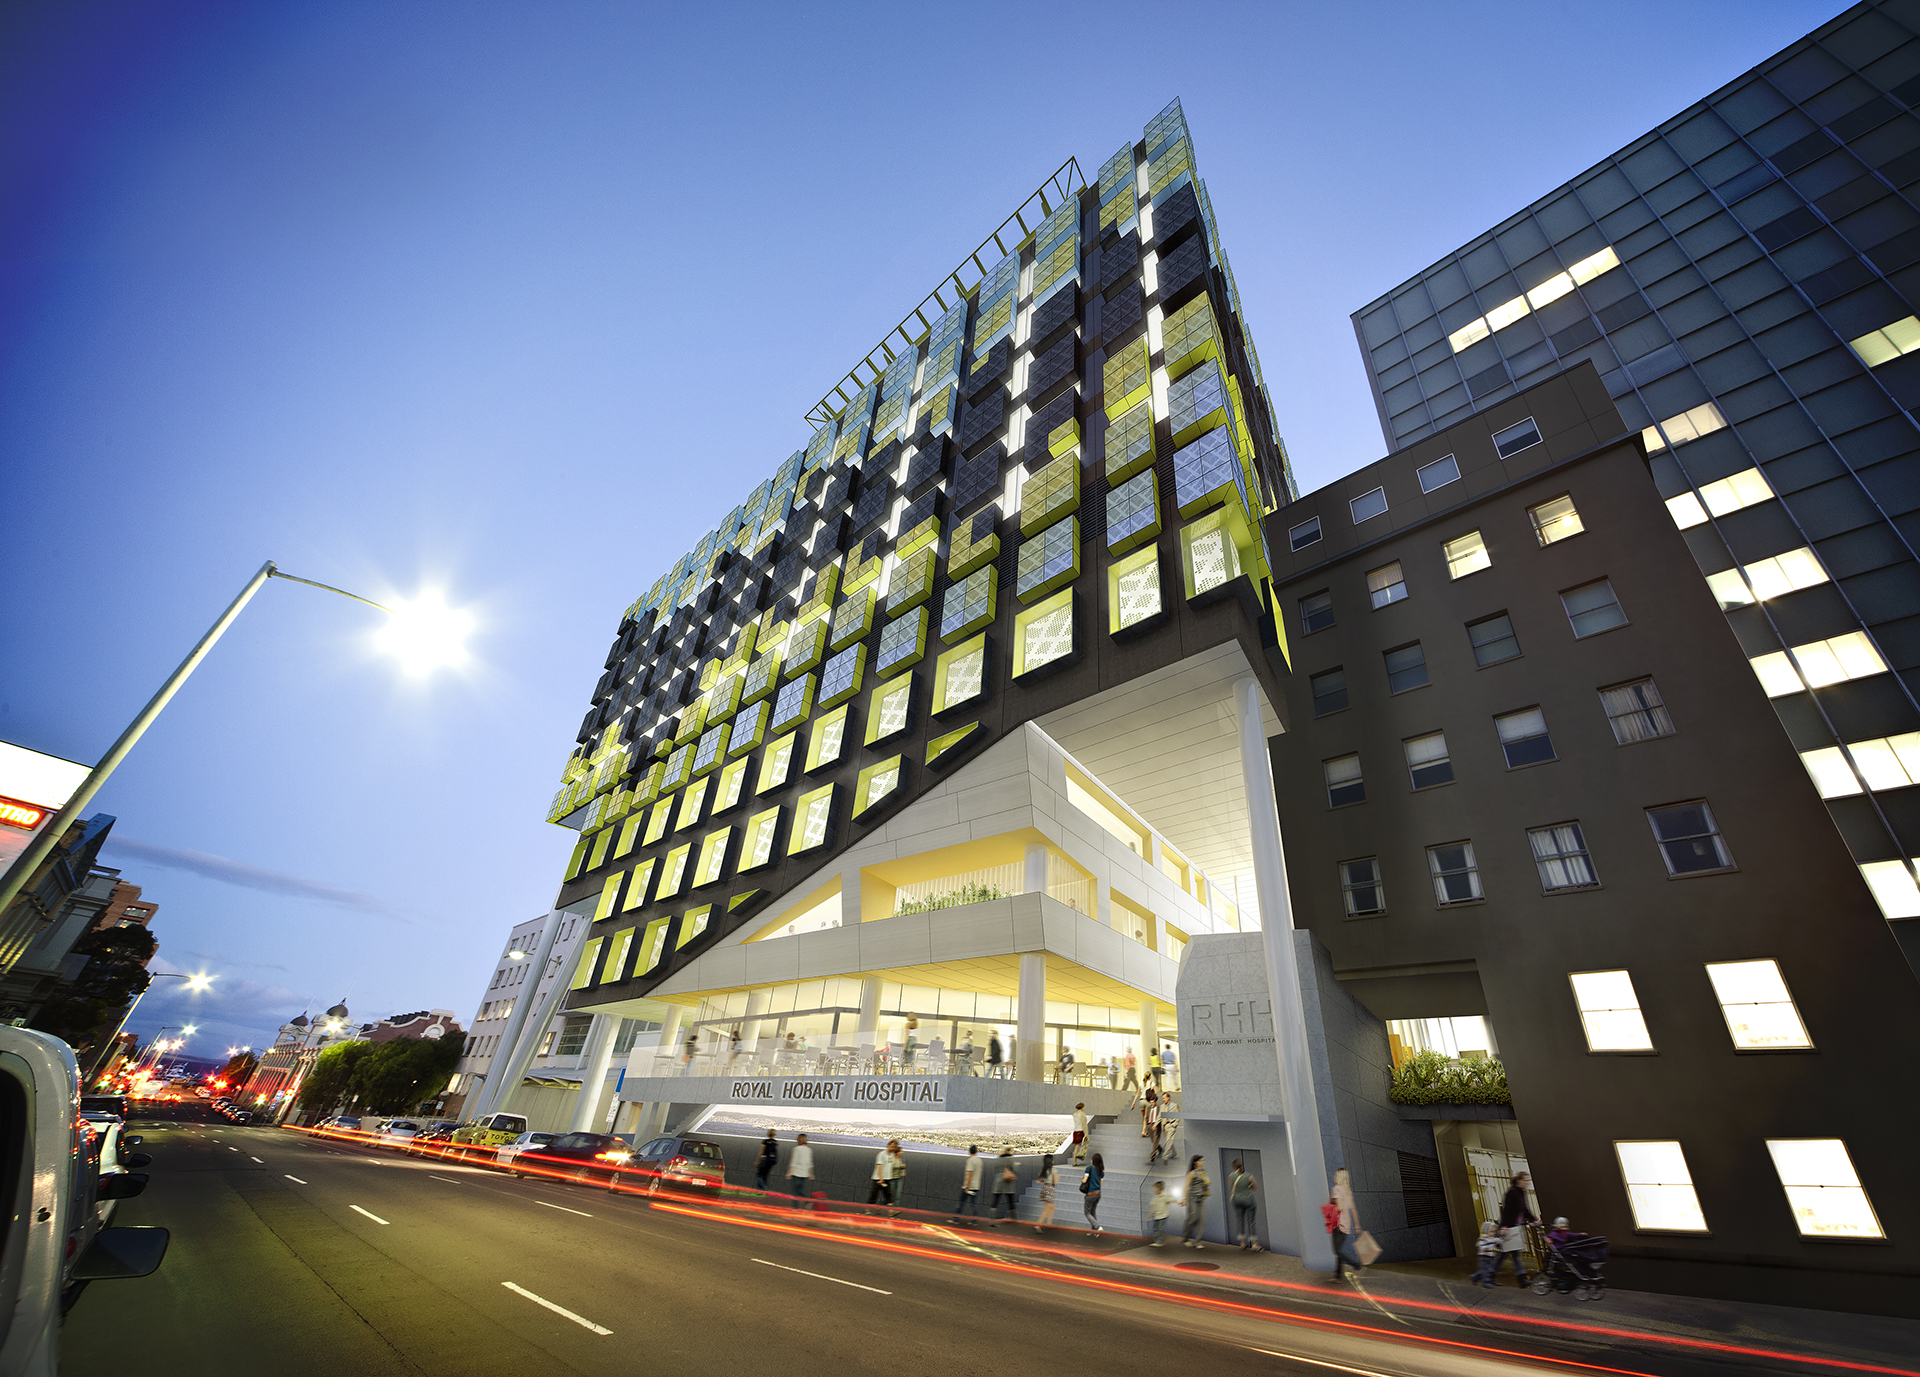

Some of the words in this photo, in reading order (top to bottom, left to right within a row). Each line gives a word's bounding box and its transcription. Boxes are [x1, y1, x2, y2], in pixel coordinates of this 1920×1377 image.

[1191, 1000, 1274, 1035] RHH
[731, 1081, 773, 1099] ROYAL
[782, 1081, 844, 1100] HOBART
[853, 1081, 944, 1102] HOSPITAL
[491, 1133, 514, 1141] TOYOT
